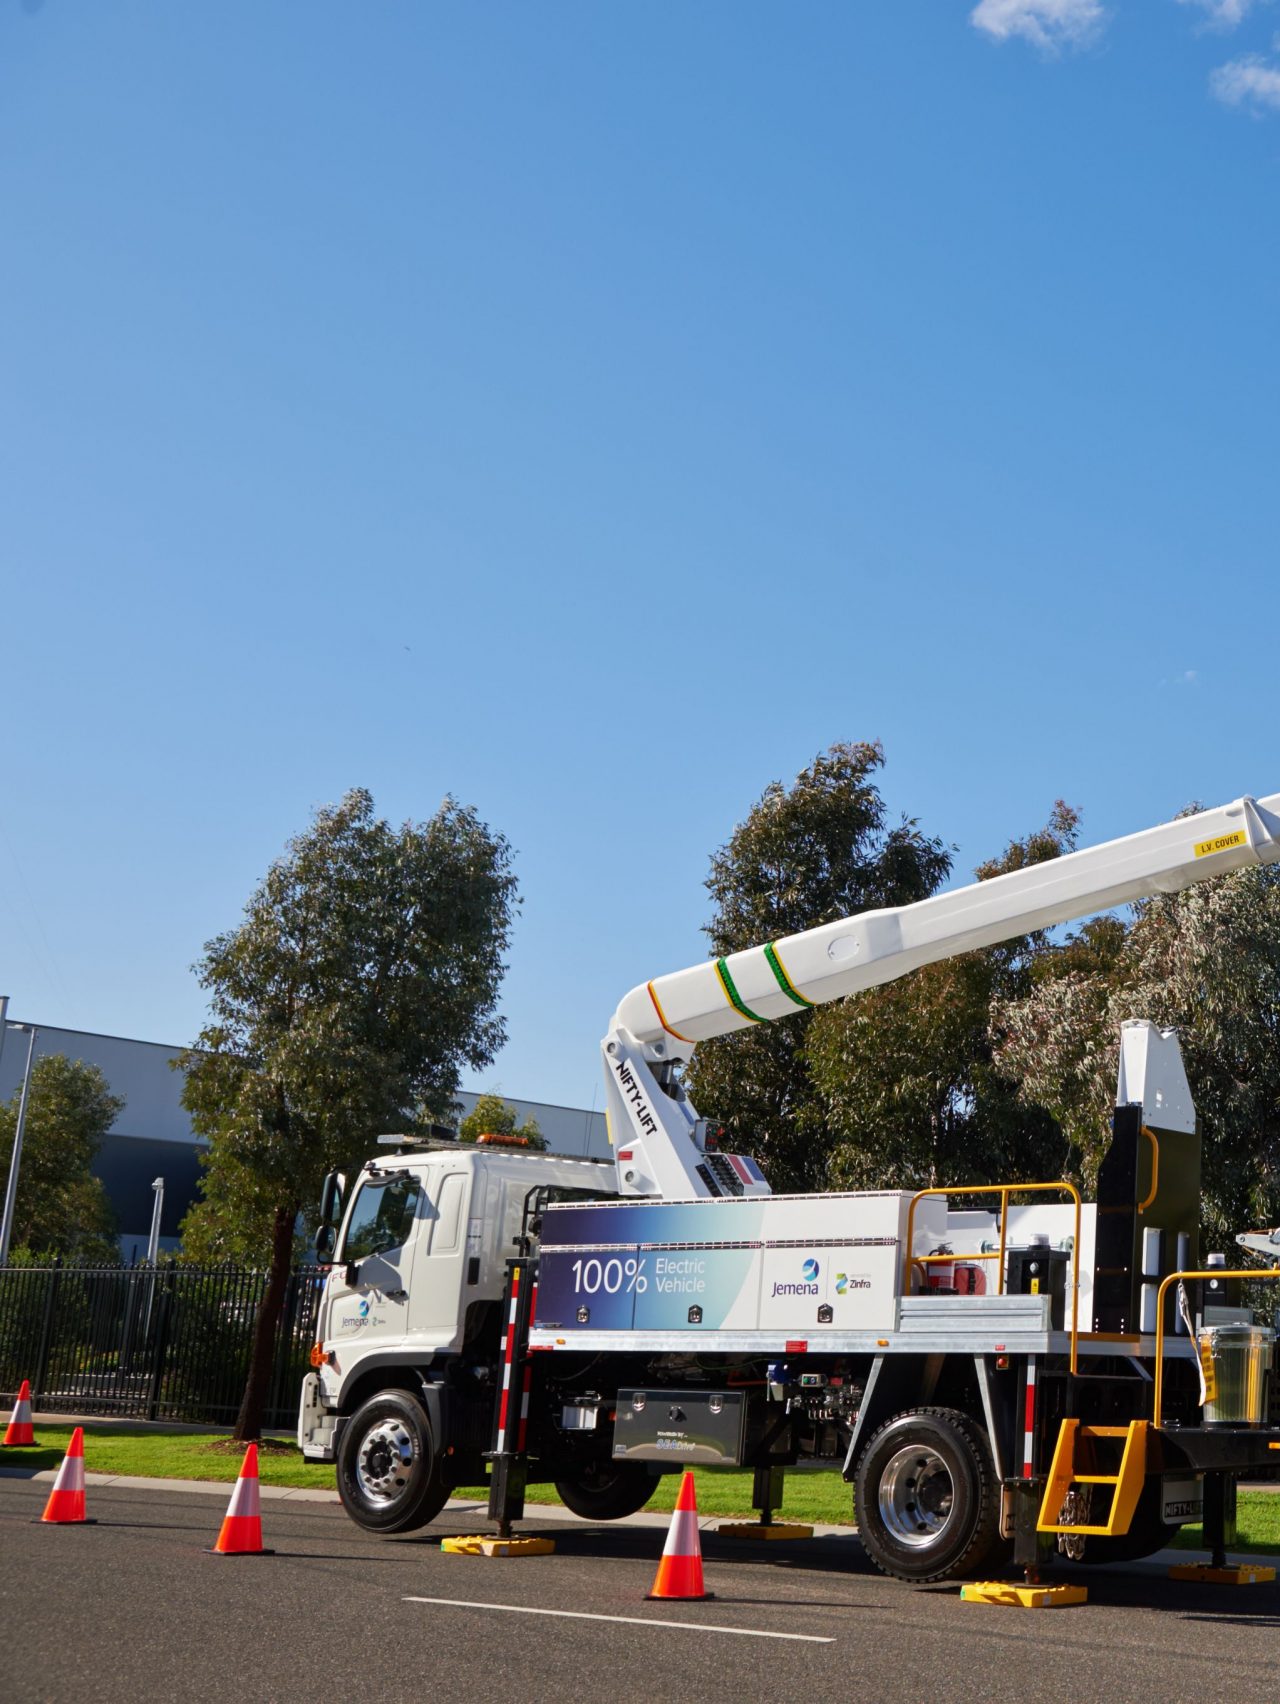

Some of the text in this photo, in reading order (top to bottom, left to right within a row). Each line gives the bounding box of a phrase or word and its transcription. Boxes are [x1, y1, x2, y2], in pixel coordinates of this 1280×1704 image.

[1215, 834, 1240, 849] COVER
[616, 1061, 658, 1136] NIFTY-LIFT
[655, 1257, 706, 1275] Electric
[572, 1258, 648, 1294] 100%
[655, 1275, 706, 1293] Vehicle
[849, 1278, 872, 1289] Zinfra
[771, 1281, 819, 1298] Jemena
